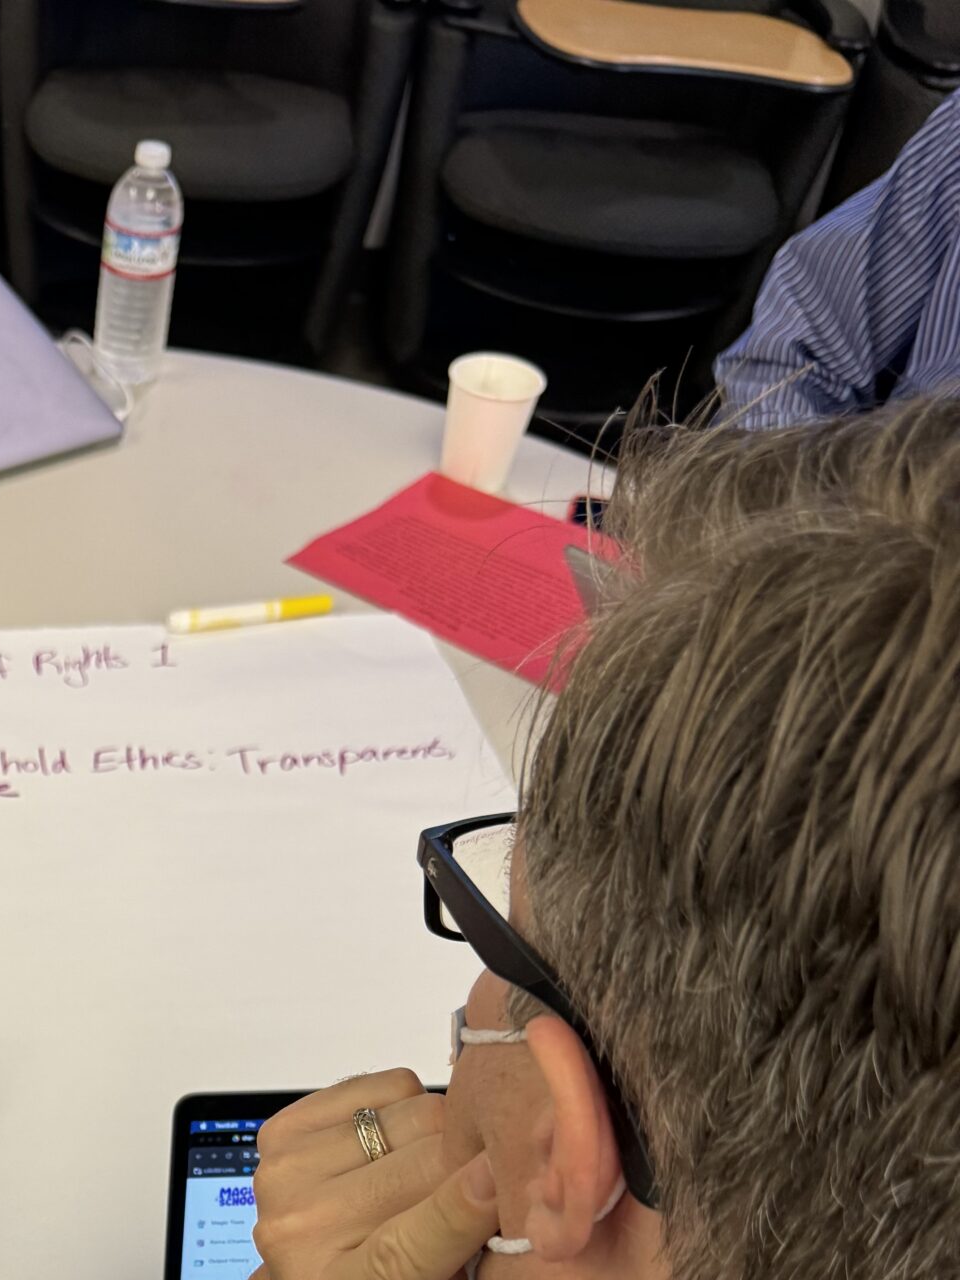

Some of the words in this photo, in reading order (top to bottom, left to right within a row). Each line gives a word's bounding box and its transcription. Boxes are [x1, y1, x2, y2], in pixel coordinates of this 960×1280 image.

[32, 645, 128, 688] Rights
[220, 1186, 254, 1198] MAGI
[219, 1196, 256, 1207] SCHOO
